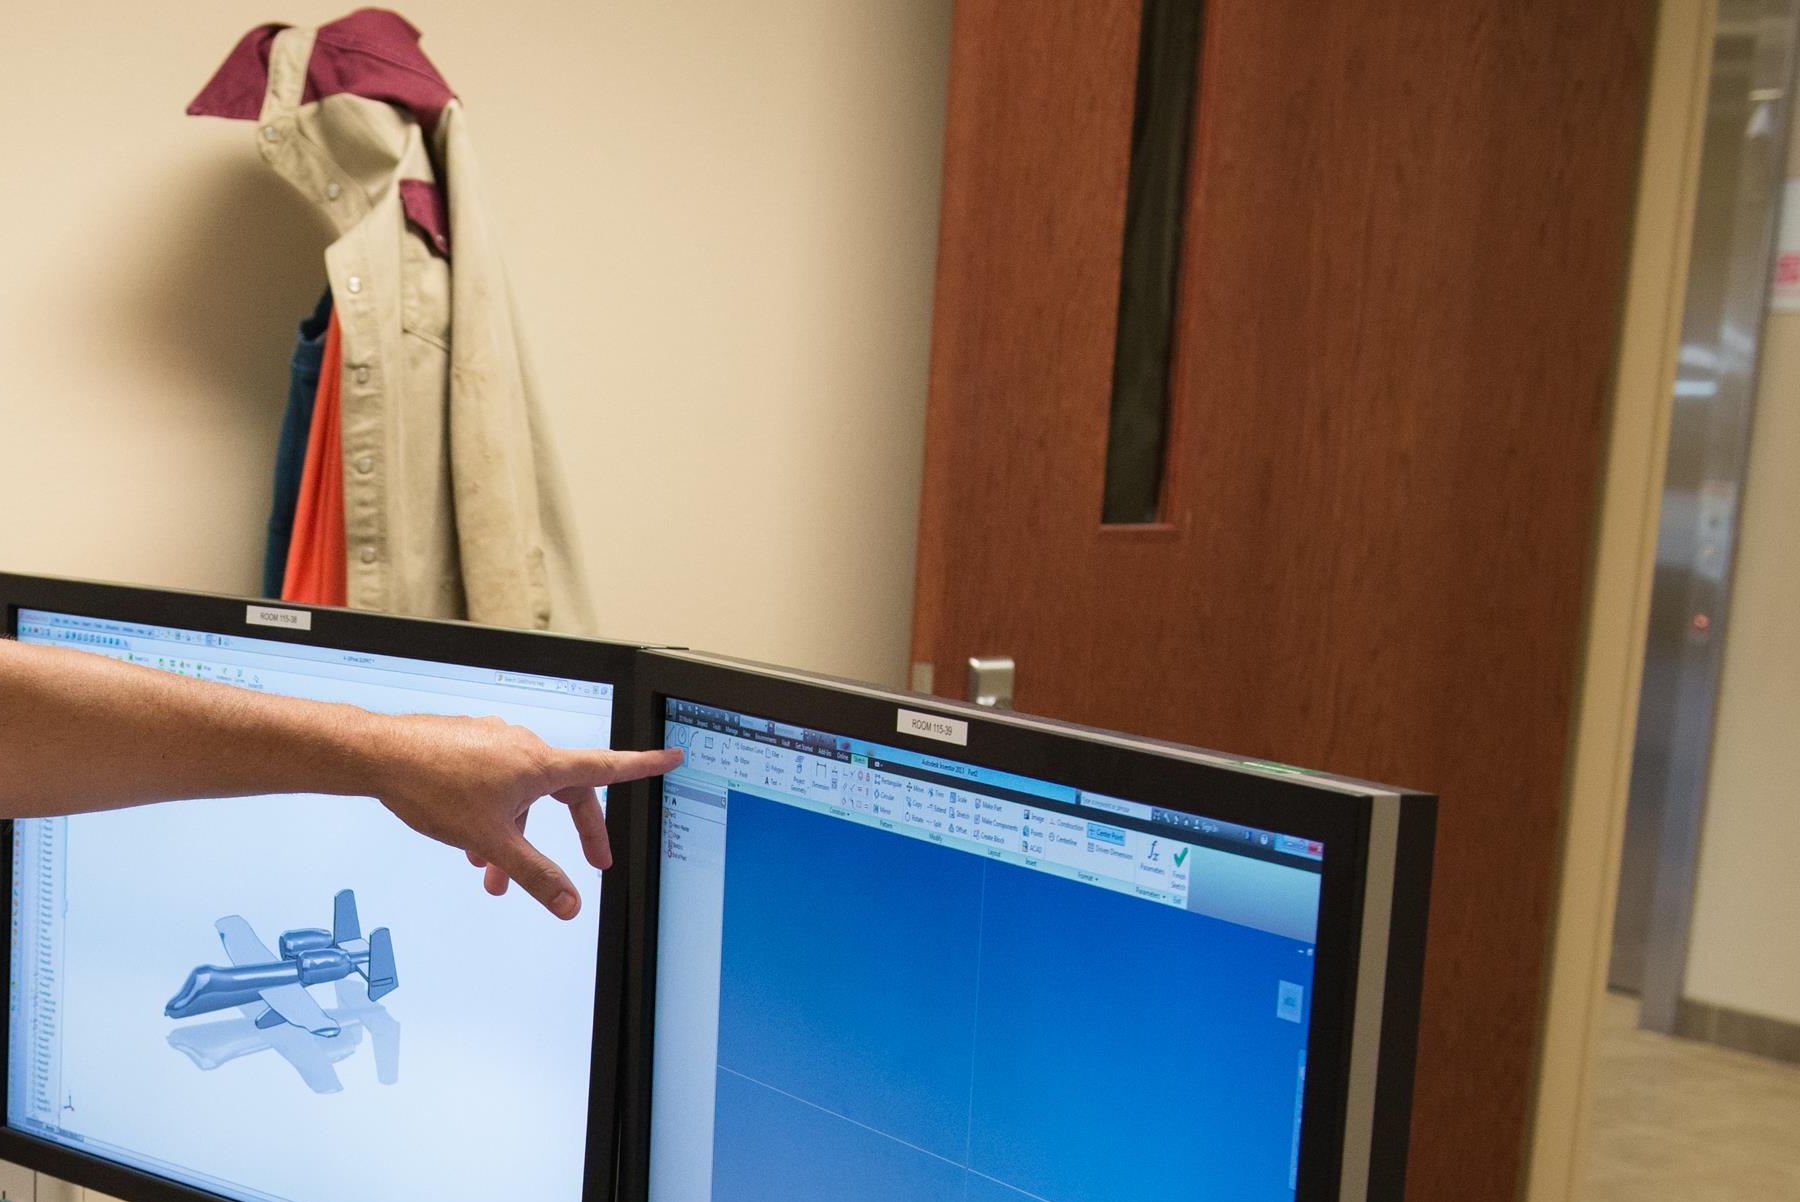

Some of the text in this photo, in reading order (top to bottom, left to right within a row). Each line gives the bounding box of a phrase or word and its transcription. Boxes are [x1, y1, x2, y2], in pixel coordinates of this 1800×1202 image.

[260, 612, 278, 622] ROOM
[912, 718, 952, 736] ROOM 115-39
